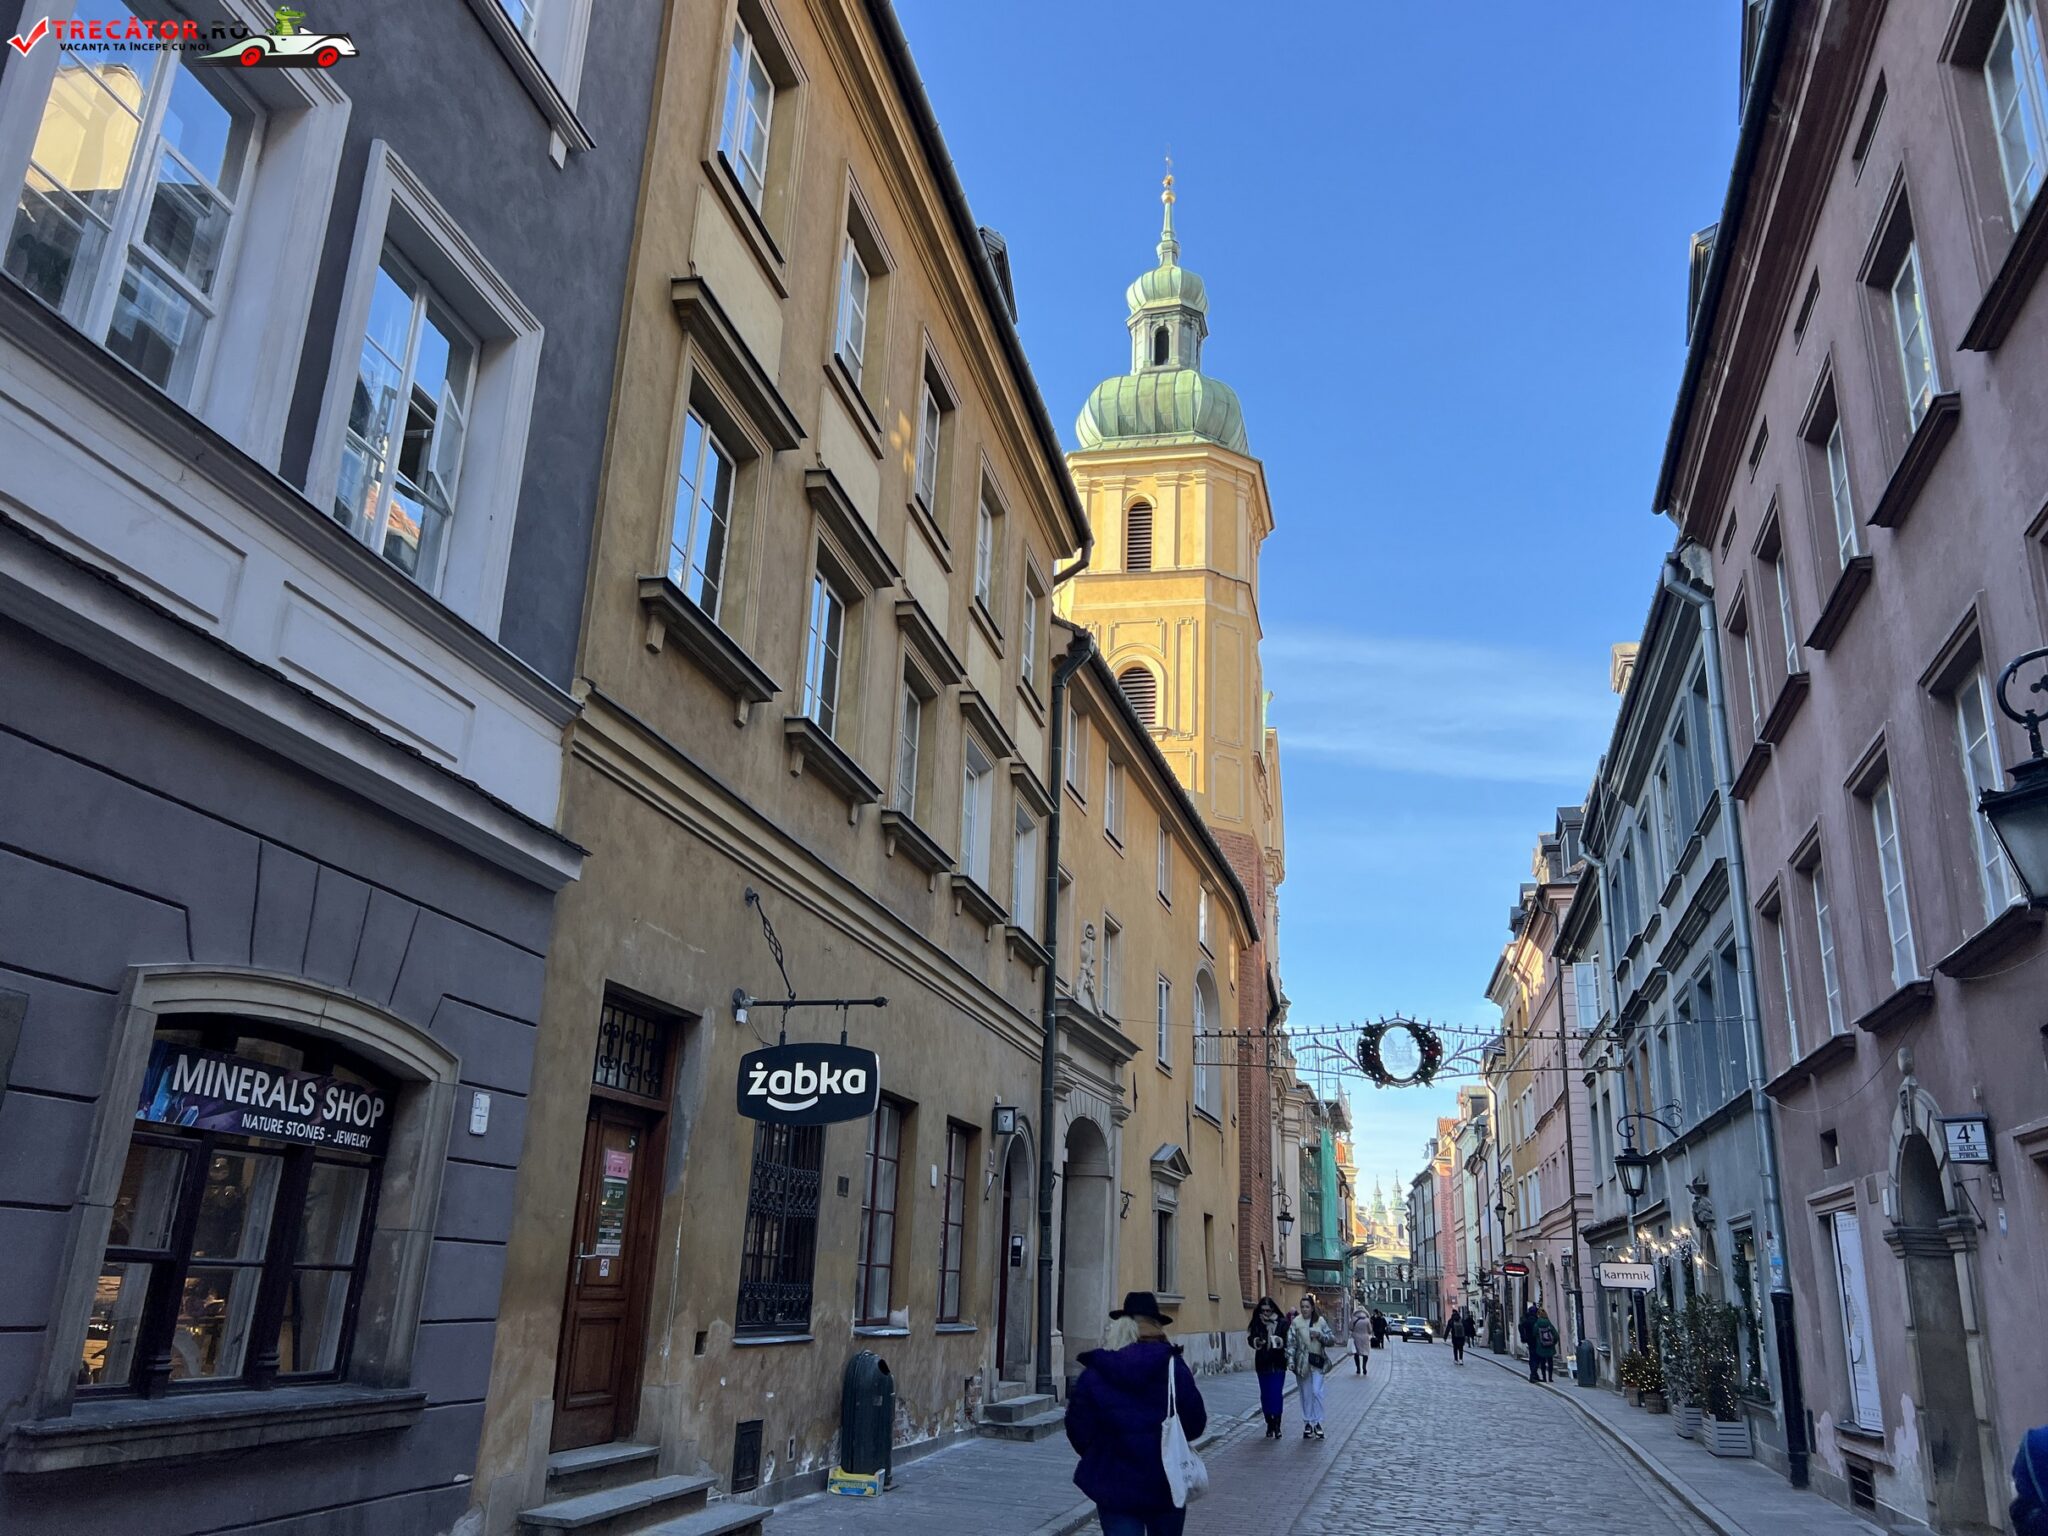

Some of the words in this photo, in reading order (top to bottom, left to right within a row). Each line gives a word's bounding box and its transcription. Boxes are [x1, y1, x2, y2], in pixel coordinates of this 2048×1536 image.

[172, 1054, 317, 1116] MINERALS
[322, 1086, 385, 1128] SHOP
[747, 1061, 867, 1096] żabka
[241, 1113, 284, 1134] NATURE
[285, 1121, 326, 1140] STONES
[333, 1130, 372, 1149] JEWELRY
[1003, 1115, 1009, 1124] 7
[1603, 1269, 1651, 1281] karmnik
